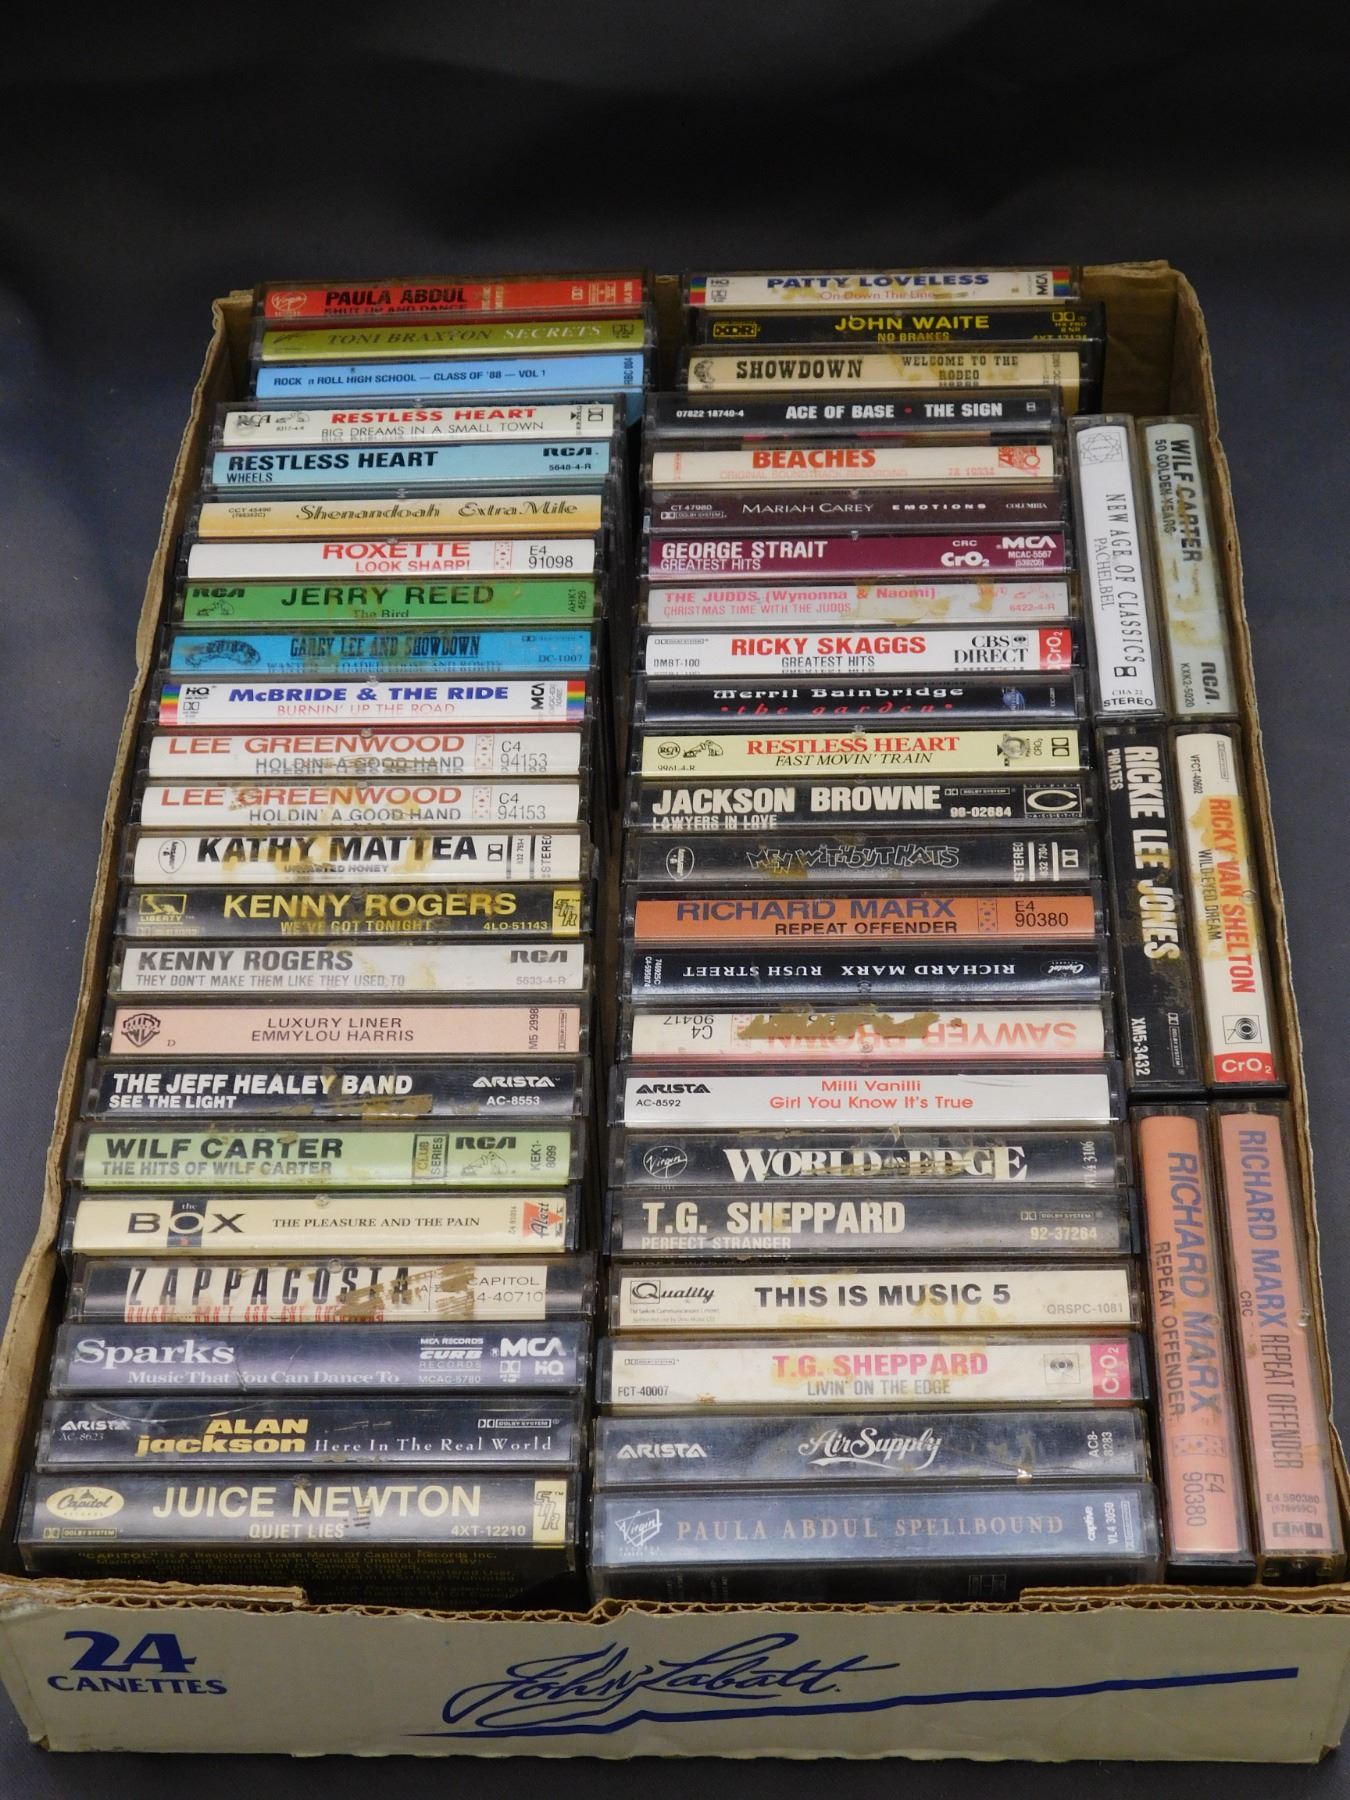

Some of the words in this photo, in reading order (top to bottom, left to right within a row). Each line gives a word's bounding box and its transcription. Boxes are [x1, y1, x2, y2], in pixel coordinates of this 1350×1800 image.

[766, 276, 850, 289] PATTY
[858, 274, 990, 287] LOVELESS
[325, 289, 391, 305] PAULA
[401, 288, 467, 305] ABDUL
[834, 317, 902, 332] JOHN
[909, 315, 990, 330] WAITE
[327, 333, 380, 345] TONI
[388, 329, 492, 343] BRAXTON
[503, 325, 601, 340] SECRETS
[736, 359, 863, 379] SHOWDOWN
[901, 356, 966, 366] WELCOME
[970, 356, 989, 366] TO
[994, 356, 1018, 366] THE
[332, 410, 443, 424] RESTLESS
[454, 408, 536, 421] HEART
[786, 404, 819, 419] ACE
[824, 404, 846, 418] OF
[851, 404, 894, 418] BASE
[924, 404, 955, 417] THE
[962, 402, 1003, 417] SIGN
[228, 453, 349, 471] RESTLESS
[358, 450, 439, 468] HEART
[752, 450, 876, 468] BEACHES
[1170, 439, 1194, 483] WILF
[226, 471, 273, 483] WHEELS
[742, 503, 815, 513] MARIAH
[819, 502, 875, 513] CAREY
[1177, 487, 1202, 563] CARTER
[322, 543, 471, 560] ROXETTE
[530, 545, 547, 555] E4
[662, 542, 742, 559] GEORGE
[751, 541, 828, 558] STRAIT
[529, 555, 574, 569] 91098
[661, 559, 727, 571] GREATEST
[731, 558, 761, 570] HITS
[281, 586, 389, 606] JERRY
[403, 585, 495, 604] REED
[664, 603, 727, 616] CHRISTMAS
[731, 603, 757, 614] TIME
[760, 603, 790, 614] WITH
[793, 603, 813, 614] THE
[816, 601, 851, 614] JUDDS
[731, 638, 810, 657] RICKY
[817, 636, 927, 655] SKAGGS
[971, 636, 1010, 649] CBS
[538, 654, 583, 663] DC-1007
[781, 655, 839, 668] GREATEST
[843, 655, 875, 667] HITS
[953, 648, 1029, 664] DIRECT
[1103, 696, 1153, 708] STEREO
[169, 738, 231, 754] LEE
[244, 735, 465, 754] GREENWOOD
[747, 738, 871, 756] RESTLESS
[874, 736, 960, 753] HEART
[500, 753, 548, 767] 94153
[1107, 749, 1123, 791] PIRATES
[1124, 746, 1165, 819] RICKIE
[160, 788, 223, 806] LEE
[238, 787, 463, 805] GREENWOOD
[652, 787, 796, 816] JACKSON
[810, 785, 941, 812] BROWNE
[497, 805, 546, 820] 94153
[1208, 798, 1236, 856] RICKY
[196, 836, 319, 862] KATHY
[328, 836, 477, 861] MATTEA
[1132, 829, 1170, 869] LEE
[1216, 860, 1242, 898] VAN
[223, 894, 350, 919] KENNY
[364, 893, 517, 918] ROGERS
[676, 901, 837, 921] RICHARD
[849, 900, 958, 919] MARX
[1014, 901, 1036, 913] E4
[1014, 913, 1069, 928] 90380
[1137, 879, 1180, 960] JONES
[774, 922, 848, 936] REPEAT
[853, 921, 958, 935] OFFENDER
[1221, 901, 1256, 994] SHELTON
[138, 950, 235, 971] KENNY
[243, 950, 354, 971] ROGERS
[914, 963, 1016, 975] RICHARD
[683, 966, 761, 978] STREET
[767, 964, 823, 977] RUSH
[841, 964, 907, 976] MARX
[266, 1017, 342, 1029] LUXURY
[348, 1016, 402, 1029] LINER
[250, 1030, 342, 1042] EMMYLOU
[346, 1029, 415, 1042] HARRIS
[1131, 1017, 1151, 1077] XM5-3432
[113, 1074, 163, 1094] THE
[166, 1074, 229, 1094] JEFF
[233, 1074, 335, 1094] HEALEY
[341, 1074, 414, 1094] BAND
[636, 1084, 711, 1094] ARISTA
[821, 1080, 860, 1092] Milli
[865, 1080, 921, 1092] Vanilli
[108, 1095, 144, 1109] SEE
[147, 1095, 182, 1108] THE
[184, 1095, 237, 1108] LIGHT
[486, 1095, 541, 1106] AC-8553
[636, 1099, 681, 1107] AC-8592
[769, 1096, 801, 1109] Girl
[806, 1096, 844, 1109] You
[848, 1096, 897, 1109] Know
[903, 1096, 931, 1108] It's
[934, 1096, 974, 1108] True
[105, 1139, 194, 1159] WILF
[200, 1137, 343, 1159] CARTER
[101, 1161, 132, 1175] THE
[135, 1161, 182, 1175] HITS
[186, 1161, 210, 1175] OF
[215, 1161, 256, 1175] WILF
[259, 1161, 333, 1175] CARTER
[272, 1218, 300, 1228] THE
[303, 1217, 378, 1228] PLEASURE
[381, 1216, 412, 1227] AND
[416, 1216, 443, 1227] THE
[445, 1216, 481, 1227] PAIN
[642, 1202, 707, 1233] T.G.
[727, 1202, 906, 1234] SHEPPARD
[1167, 1151, 1210, 1300] RICHARD
[641, 1237, 707, 1249] PERFECT
[712, 1237, 792, 1249] STRANGER
[1030, 1228, 1098, 1241] 92-37264
[754, 1286, 828, 1307] THIS
[837, 1286, 867, 1306] IS
[879, 1285, 982, 1306] MUSIC
[992, 1284, 1010, 1304] 5
[73, 1339, 235, 1367] Sparks
[773, 1355, 824, 1377] T.G.
[832, 1354, 988, 1376] SHEPPARD
[1182, 1310, 1223, 1414] MARX
[618, 1384, 669, 1397] FCT-40007
[206, 1419, 309, 1434] ALAN
[134, 1435, 306, 1457] jackson
[313, 1439, 365, 1453] Here
[369, 1439, 391, 1452] In
[395, 1438, 435, 1452] The
[440, 1438, 486, 1452] Real
[490, 1436, 551, 1452] World
[617, 1442, 708, 1459] ARISTA
[152, 1486, 276, 1519] JUICE
[292, 1485, 480, 1518] NEWTON
[249, 1524, 305, 1540] QUIET
[307, 1523, 345, 1539] LIES
[676, 1520, 768, 1542] PAULA
[782, 1517, 878, 1539] ABDUL
[895, 1513, 1065, 1538] SPELLBOUND
[63, 1630, 198, 1675] 24
[47, 1675, 228, 1696] CANETTES
